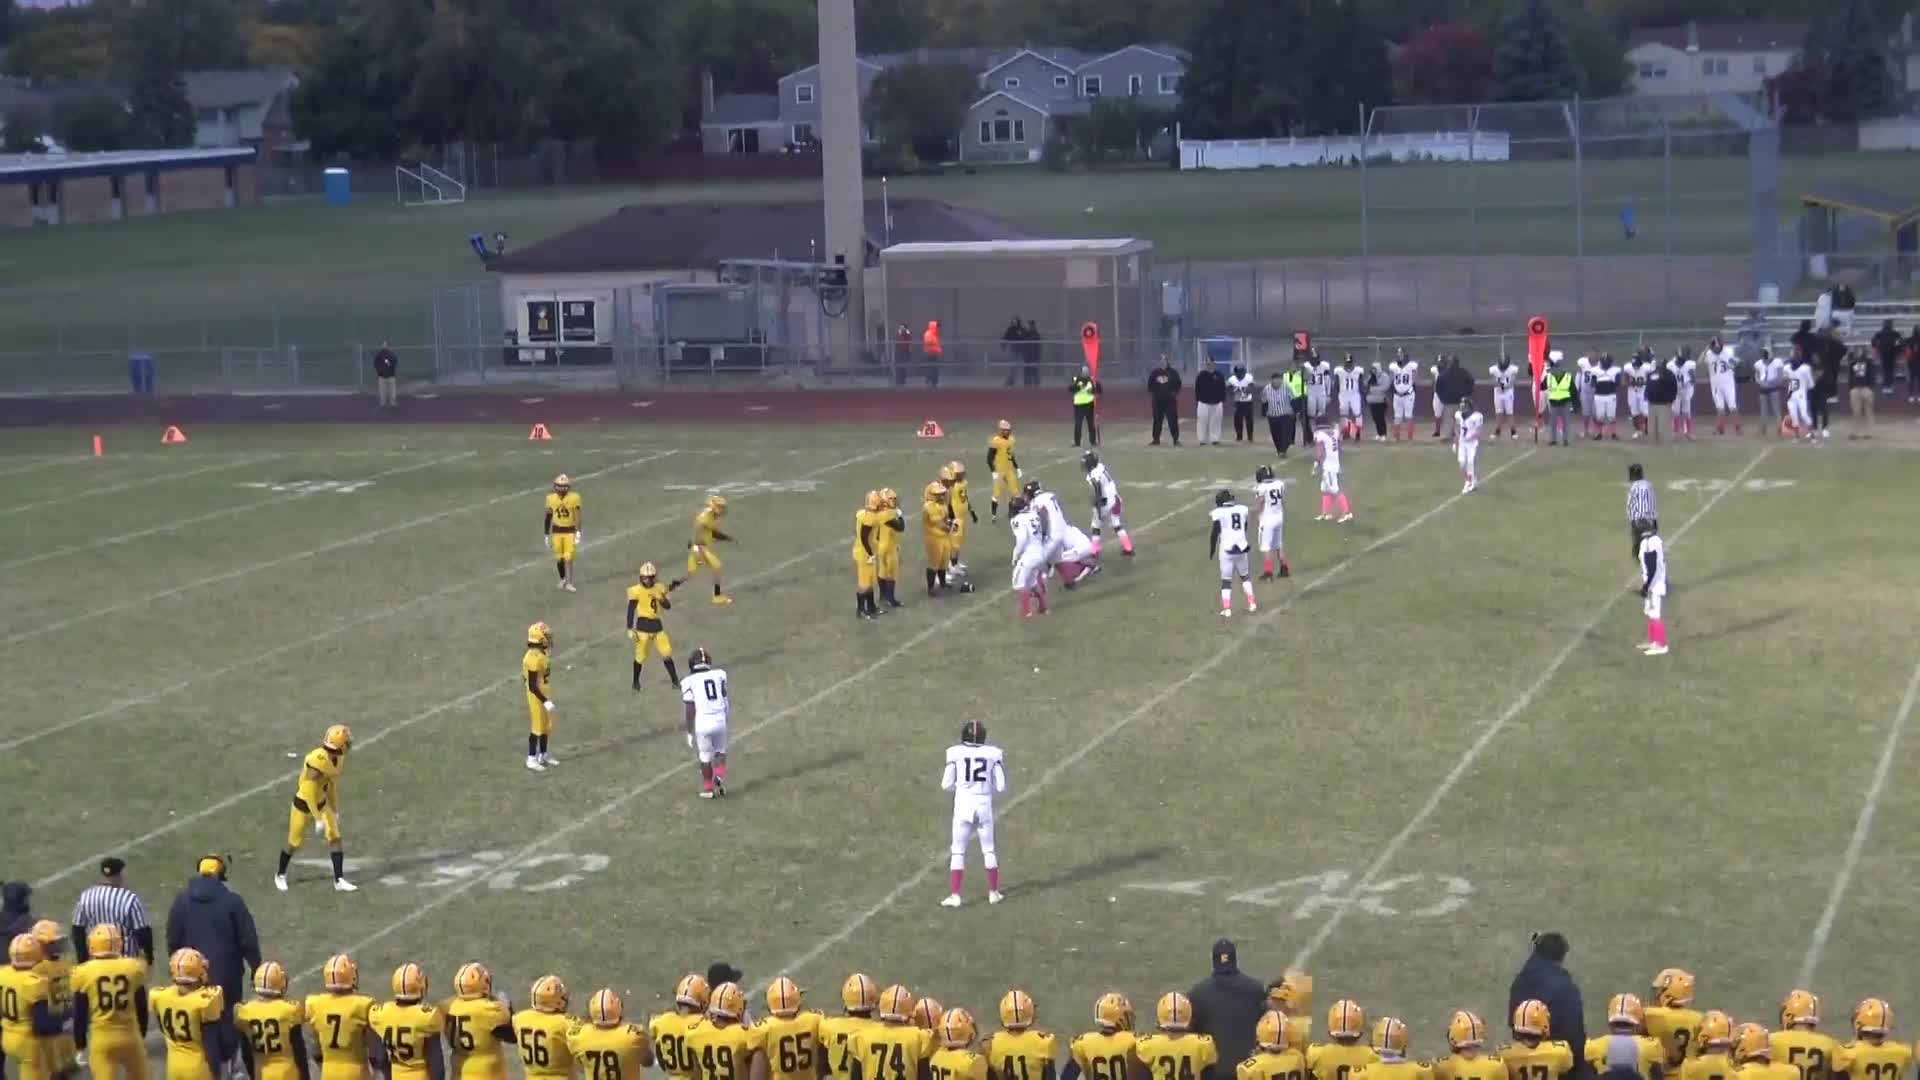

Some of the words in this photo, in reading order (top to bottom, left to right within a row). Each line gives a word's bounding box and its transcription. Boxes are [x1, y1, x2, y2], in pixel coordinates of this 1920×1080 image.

[534, 427, 544, 438] 10
[925, 423, 937, 436] 20
[1231, 513, 1241, 531] 8
[964, 757, 987, 782] 12
[97, 975, 130, 1012] 62
[163, 1008, 193, 1043] 43
[250, 1018, 283, 1054] 22
[327, 1014, 342, 1050] 7
[383, 1026, 415, 1062] 45
[521, 1028, 550, 1067] 56
[779, 1032, 813, 1073] 65
[586, 1050, 622, 1080] 78
[702, 1045, 734, 1080] 49
[871, 1044, 905, 1080] 74
[1003, 1056, 1029, 1080] 41
[1159, 1056, 1192, 1080] 34
